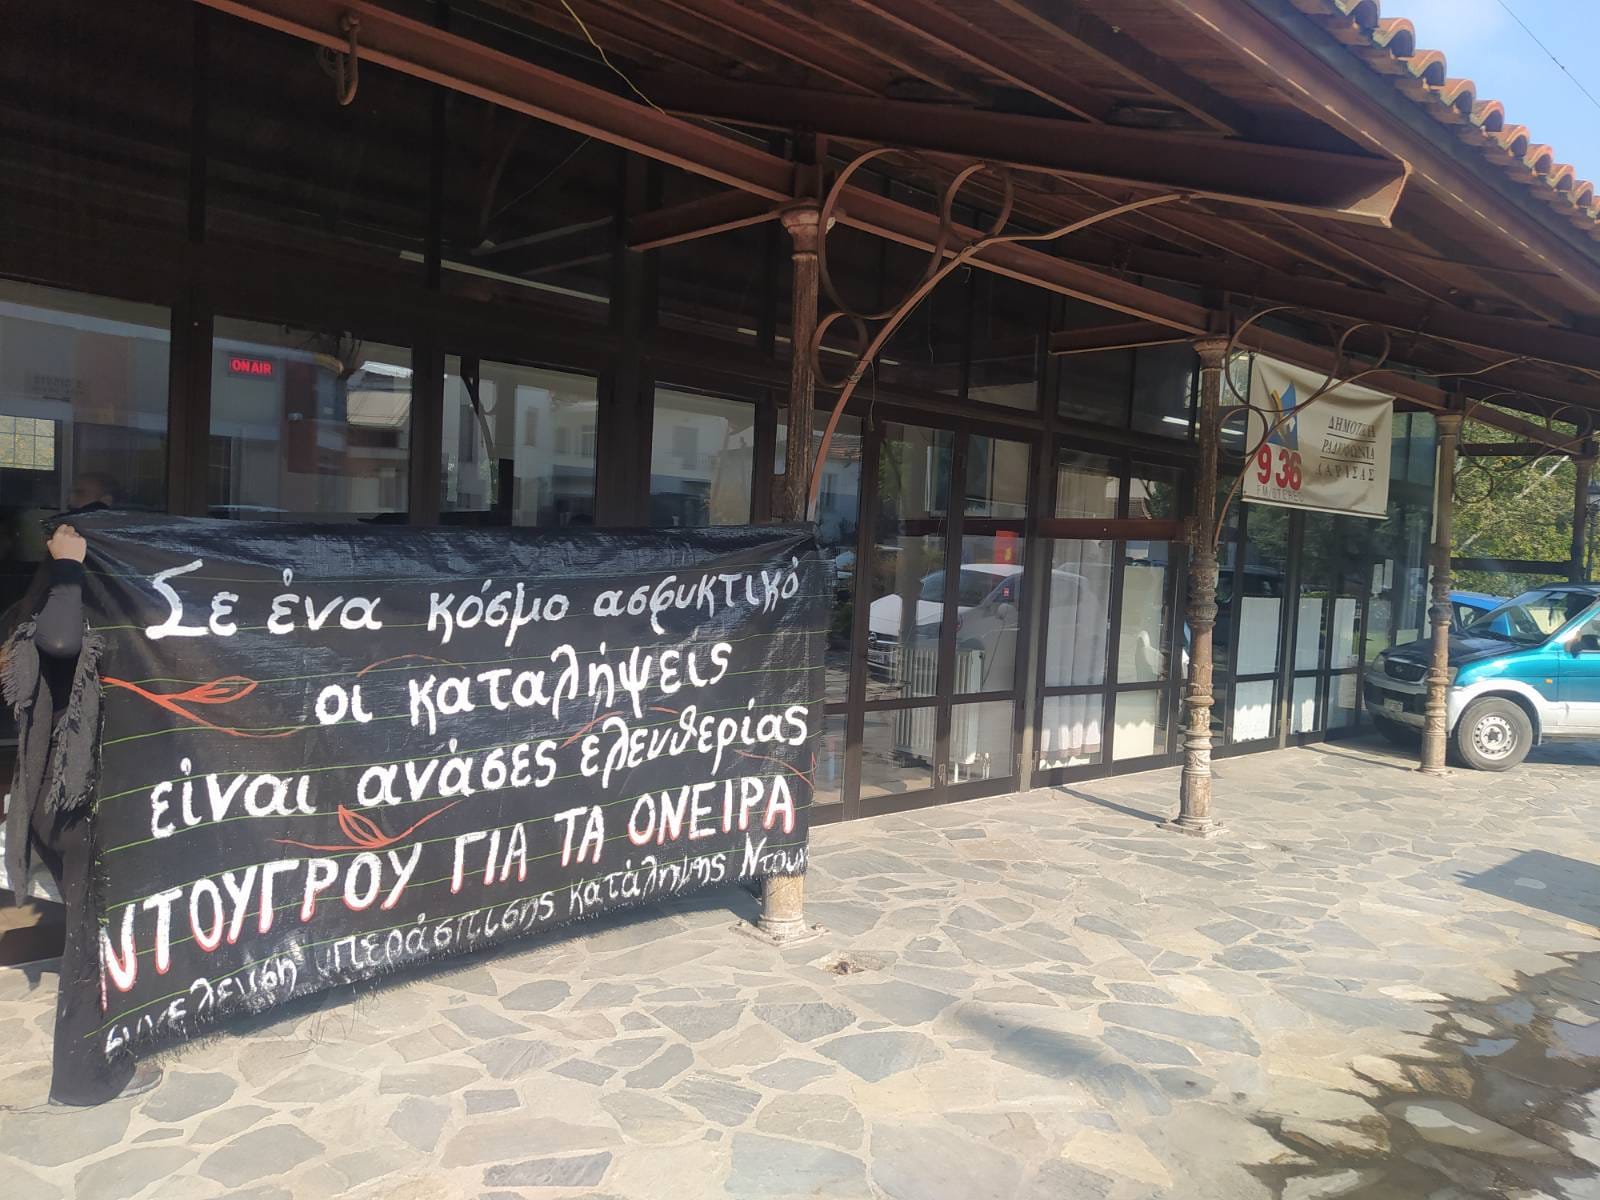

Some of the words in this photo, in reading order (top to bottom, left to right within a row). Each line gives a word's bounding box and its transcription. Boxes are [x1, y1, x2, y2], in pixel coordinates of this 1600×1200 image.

[231, 359, 249, 373] ON
[251, 361, 272, 376] AIR
[145, 558, 239, 640] Σε
[266, 567, 383, 635] ένα
[427, 579, 570, 647] κόσμο
[593, 556, 800, 635] ασφυκτικό
[314, 683, 373, 725] οι
[408, 641, 732, 736] καταλήψεις
[150, 757, 317, 839] είναι
[356, 737, 557, 807] ανάσες
[580, 697, 809, 789] ελευθερίας
[98, 842, 423, 1014] ΝΤΟΥΓΡΟΥ
[450, 822, 528, 895] ΓΙΑ
[553, 804, 605, 868] ΤΑ
[626, 774, 796, 846] ΟΝΕΙΡΑ
